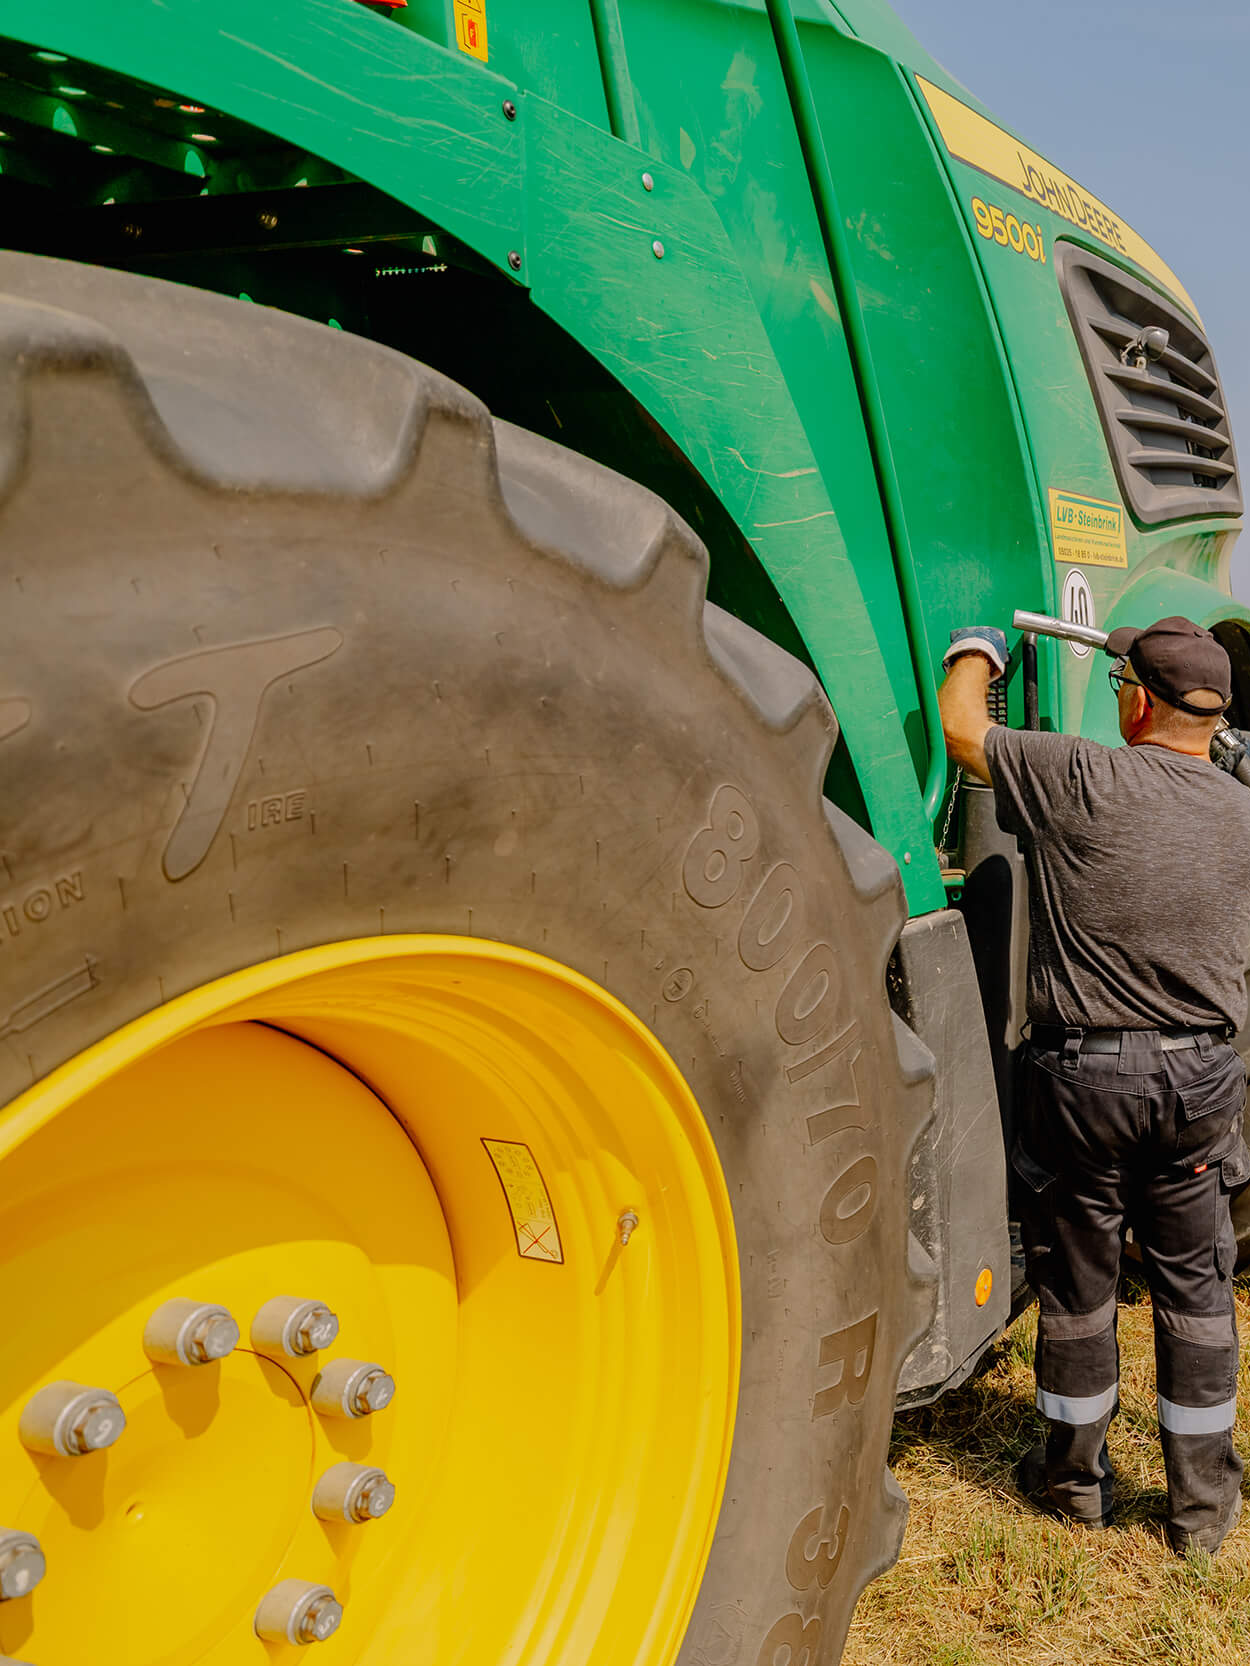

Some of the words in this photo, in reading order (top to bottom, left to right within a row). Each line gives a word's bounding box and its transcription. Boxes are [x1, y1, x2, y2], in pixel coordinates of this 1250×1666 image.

[971, 195, 1046, 265] 9500i
[0, 871, 86, 947] ION
[682, 783, 876, 1246] 800/70
